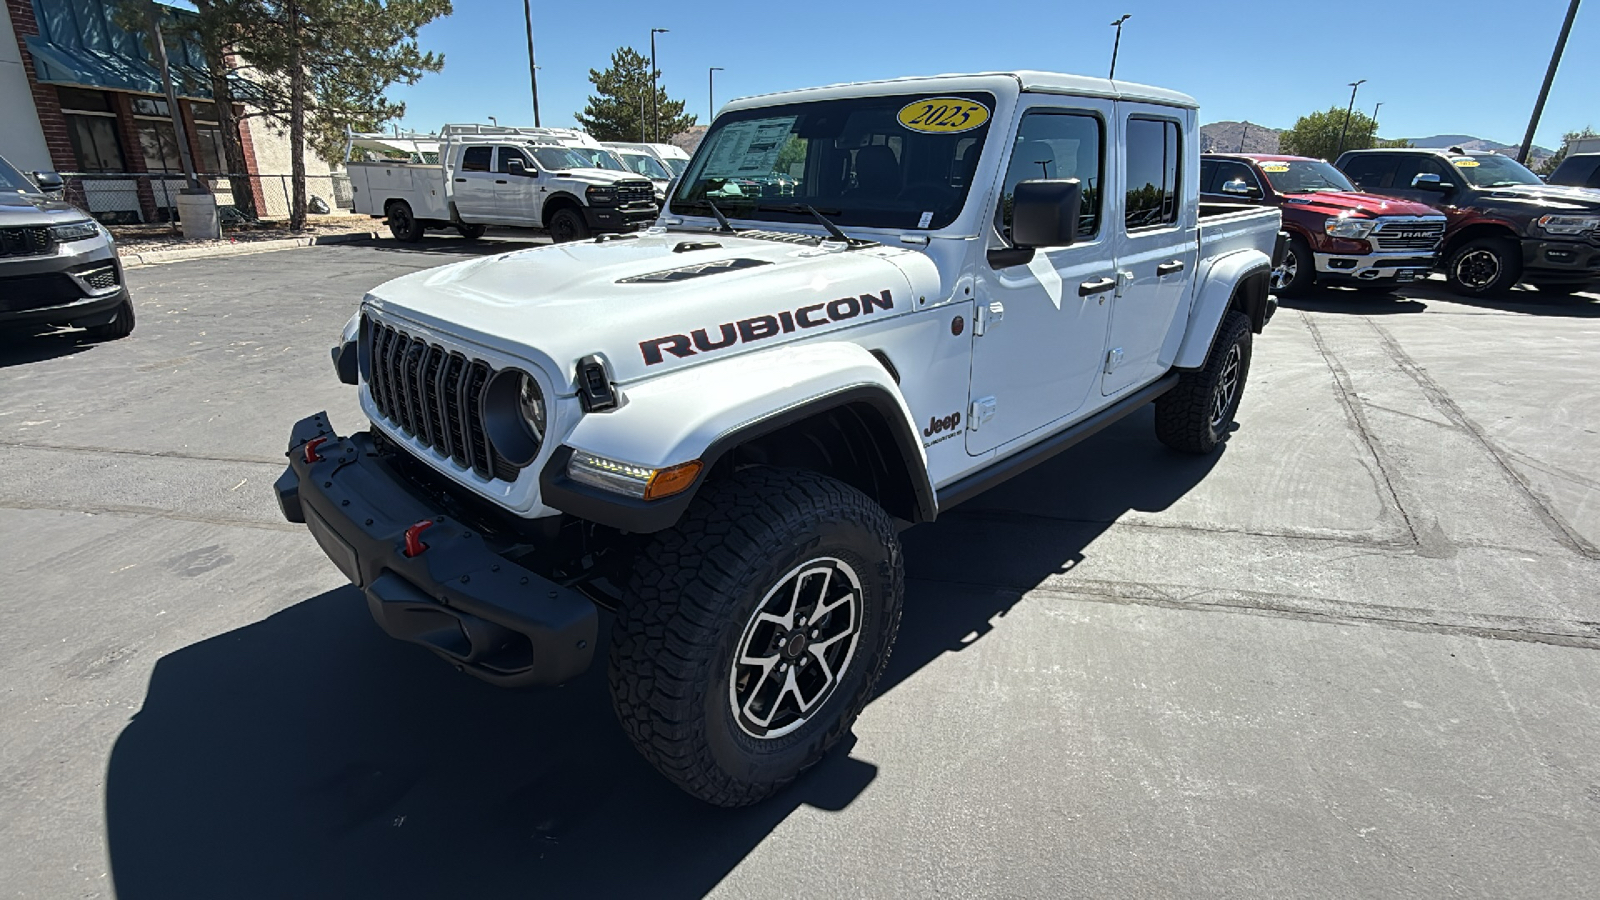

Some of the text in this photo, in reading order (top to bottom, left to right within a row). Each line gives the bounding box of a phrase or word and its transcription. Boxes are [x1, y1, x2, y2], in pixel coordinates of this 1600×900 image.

[908, 104, 980, 127] 2025
[638, 289, 894, 367] RUBICON
[923, 411, 961, 437] Jeep
